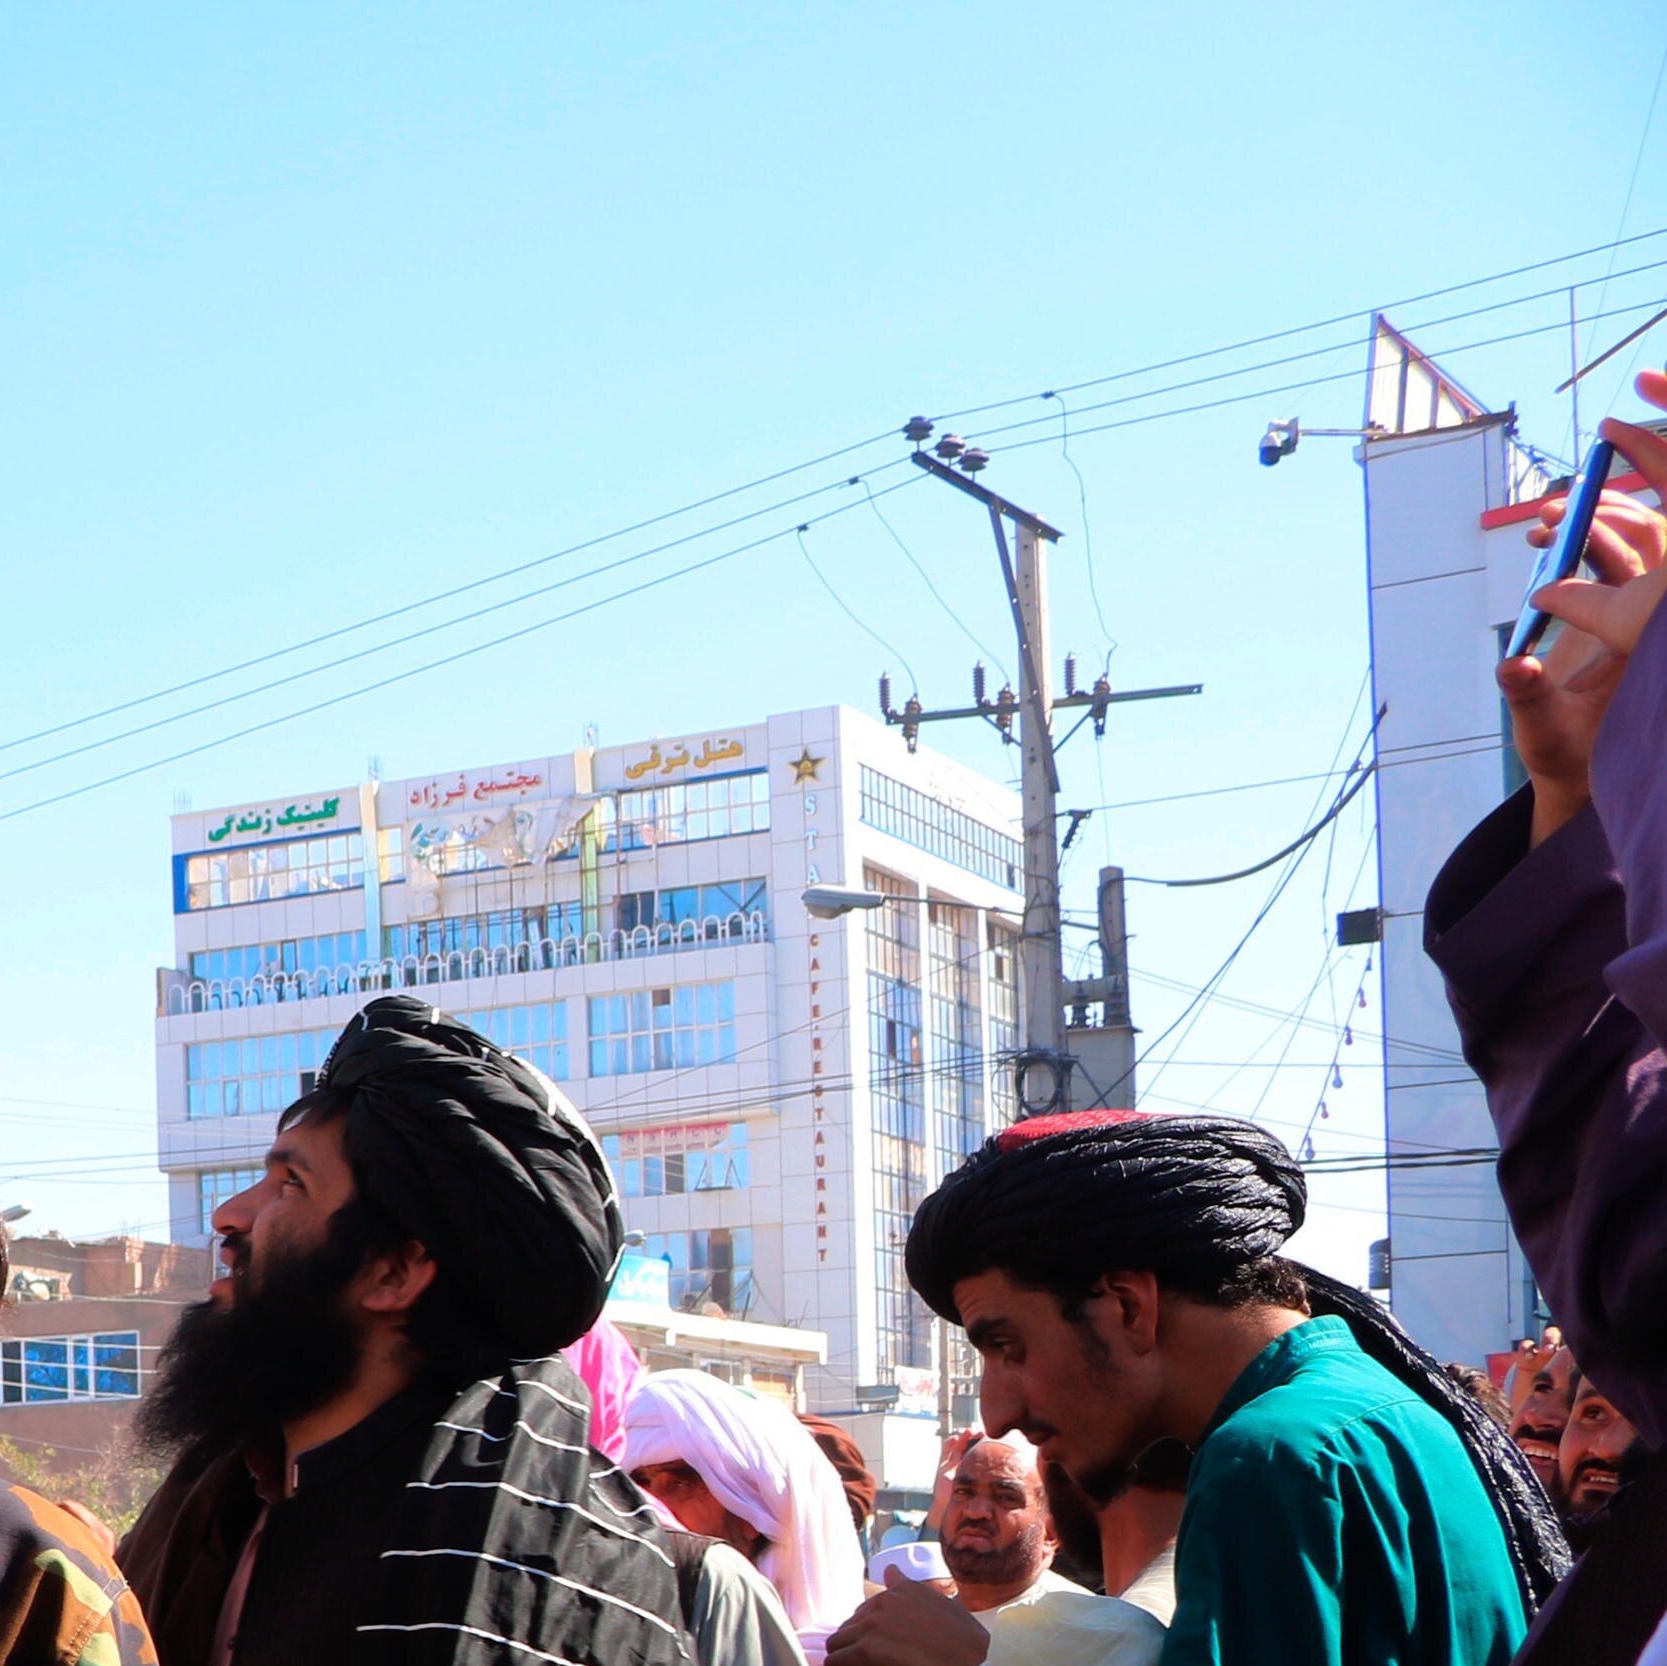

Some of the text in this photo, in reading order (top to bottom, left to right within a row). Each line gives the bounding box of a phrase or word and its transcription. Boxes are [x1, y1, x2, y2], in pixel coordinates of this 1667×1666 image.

[694, 739, 744, 768] هتل
[409, 770, 543, 809] مجتمع فرزاد
[208, 808, 273, 842] زندگی
